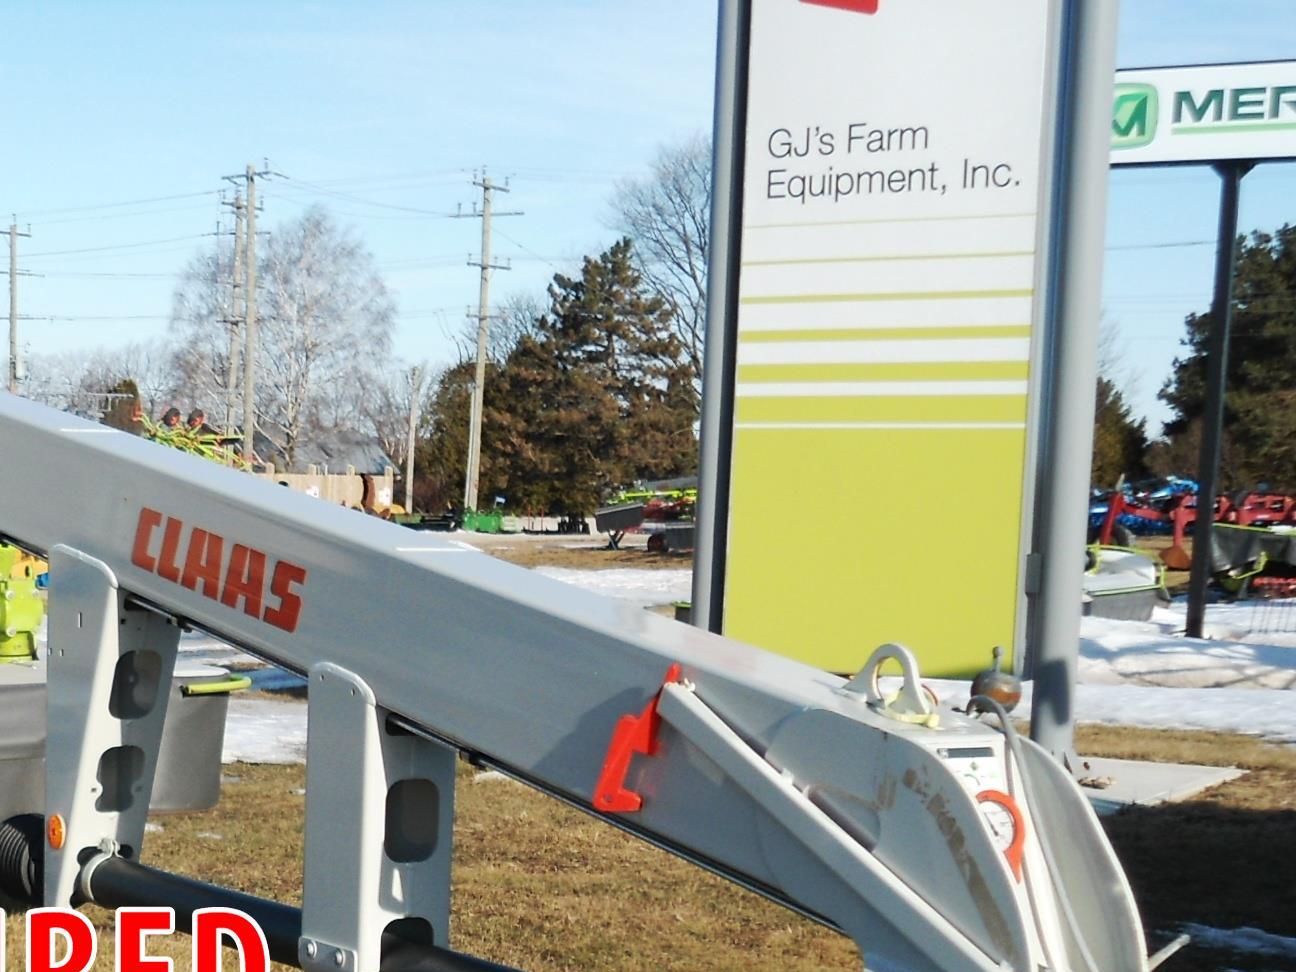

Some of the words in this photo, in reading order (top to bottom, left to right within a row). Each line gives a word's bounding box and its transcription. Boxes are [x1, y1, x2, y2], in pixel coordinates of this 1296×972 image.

[767, 126, 835, 158] GJ's
[847, 123, 929, 153] Farm
[766, 162, 948, 205] Equipment,
[961, 158, 1021, 190] Inc.
[130, 506, 307, 634] CLAAS
